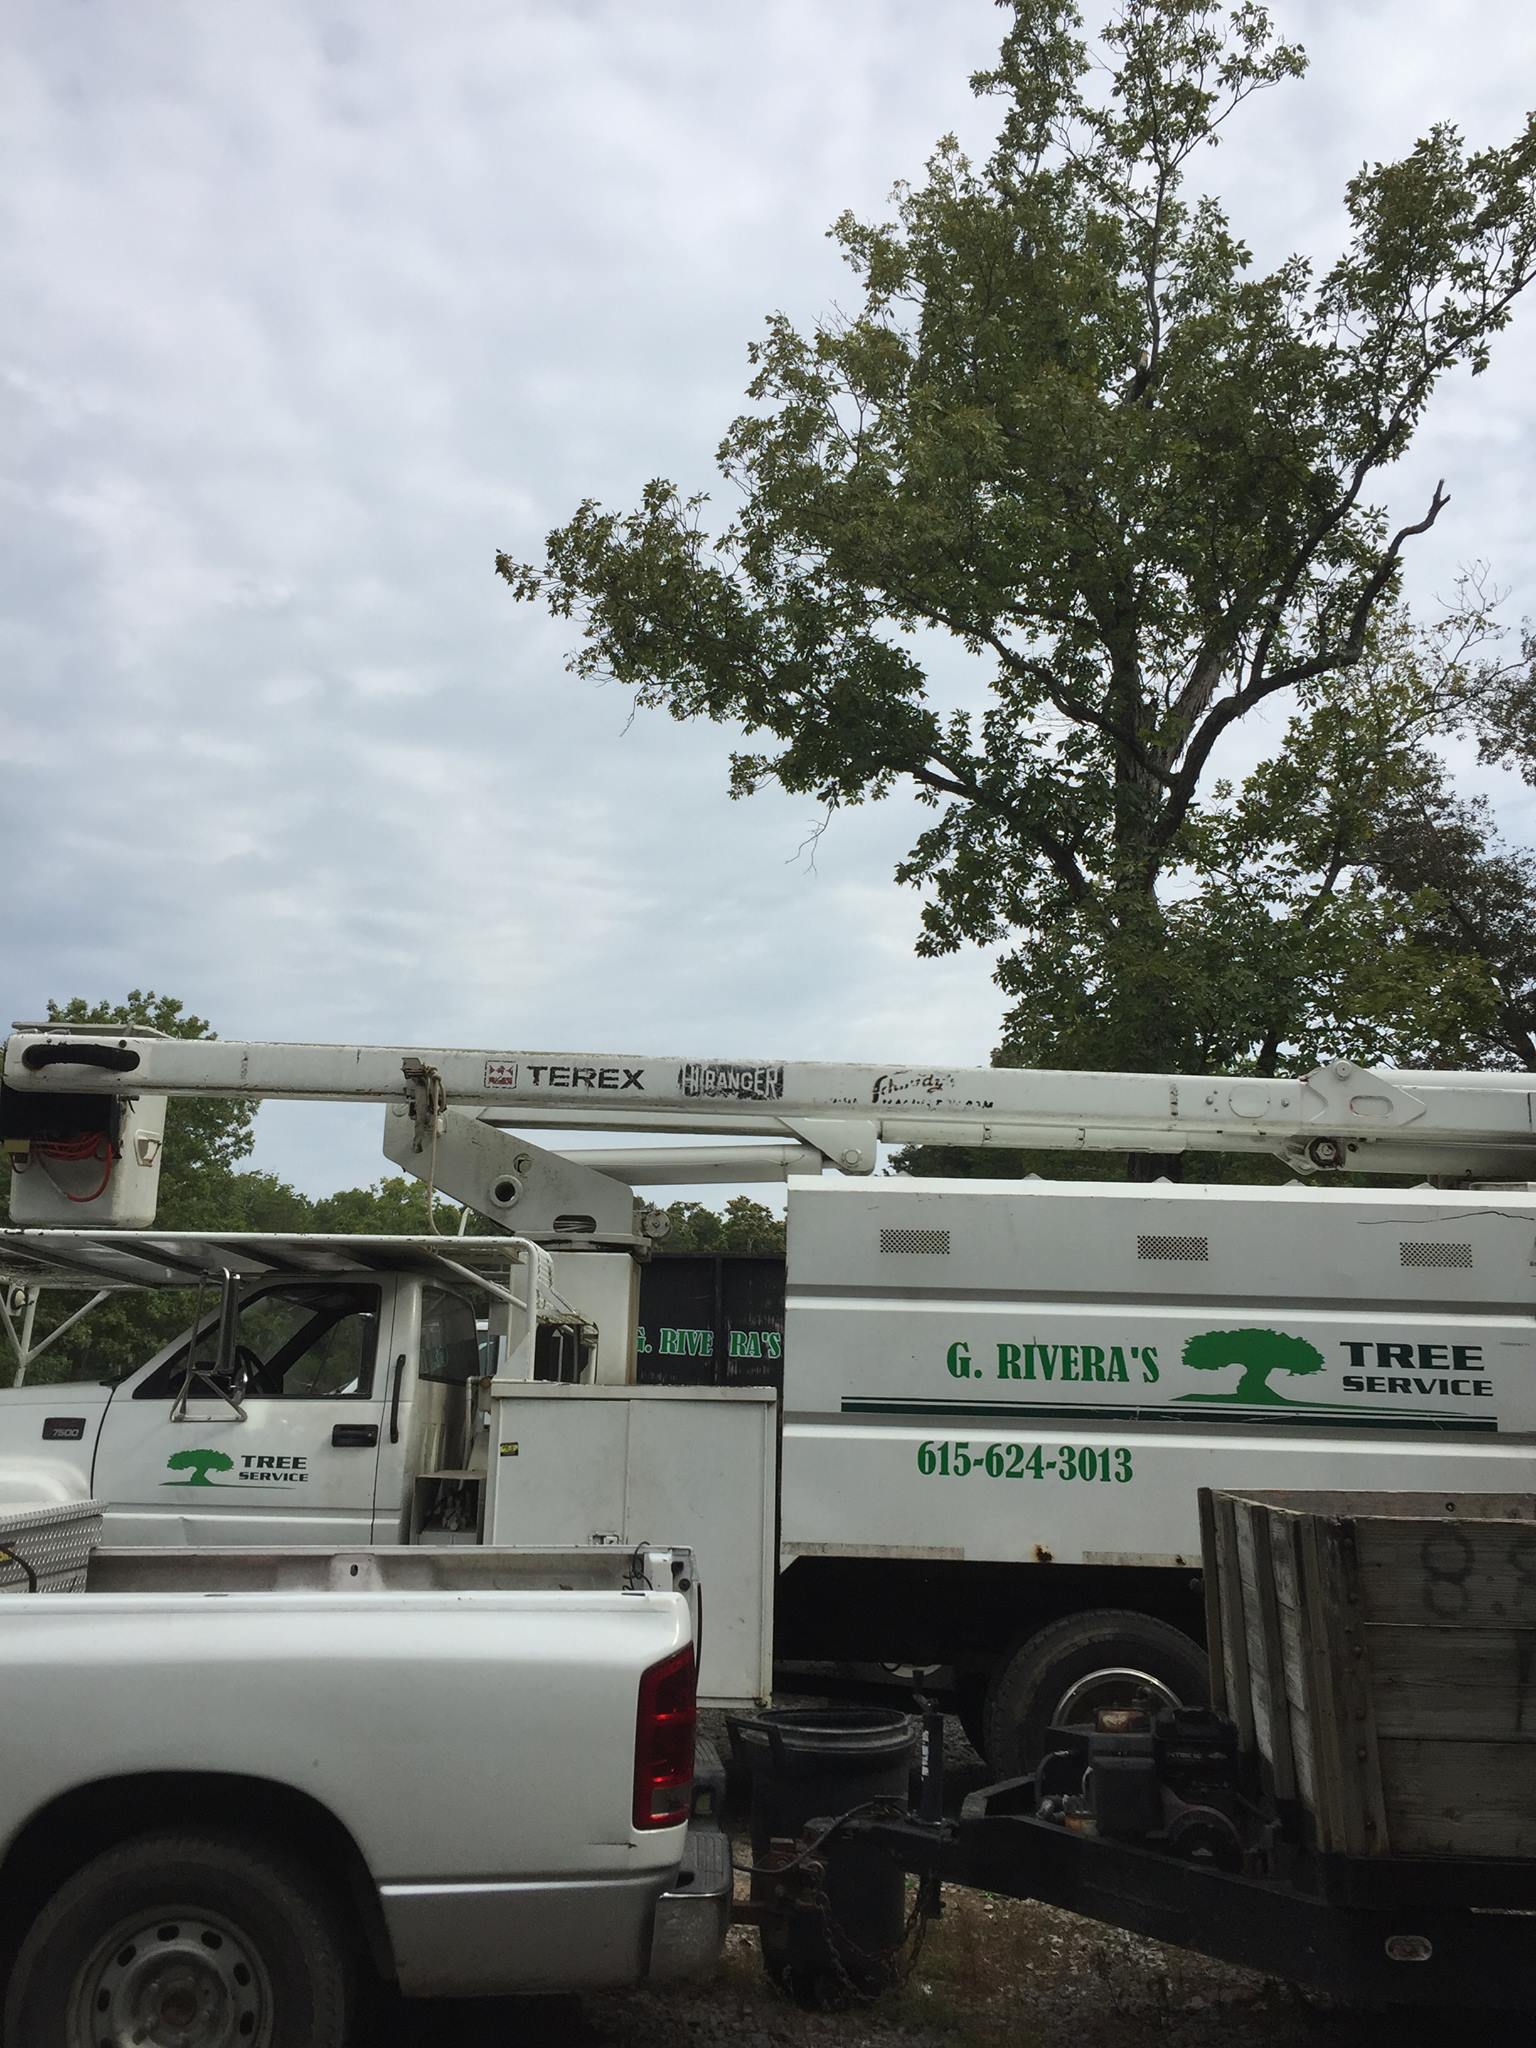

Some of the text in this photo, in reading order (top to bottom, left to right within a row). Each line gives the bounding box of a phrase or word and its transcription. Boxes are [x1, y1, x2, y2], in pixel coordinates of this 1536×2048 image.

[525, 1066, 644, 1091] TEREX
[947, 1342, 1159, 1383] G. RIVERA'S
[1341, 1342, 1485, 1371] TREE
[1343, 1375, 1493, 1397] SERVICE
[241, 1454, 307, 1470] TREE
[917, 1441, 1132, 1483] 615-624-3013
[239, 1471, 309, 1483] SERVICE
